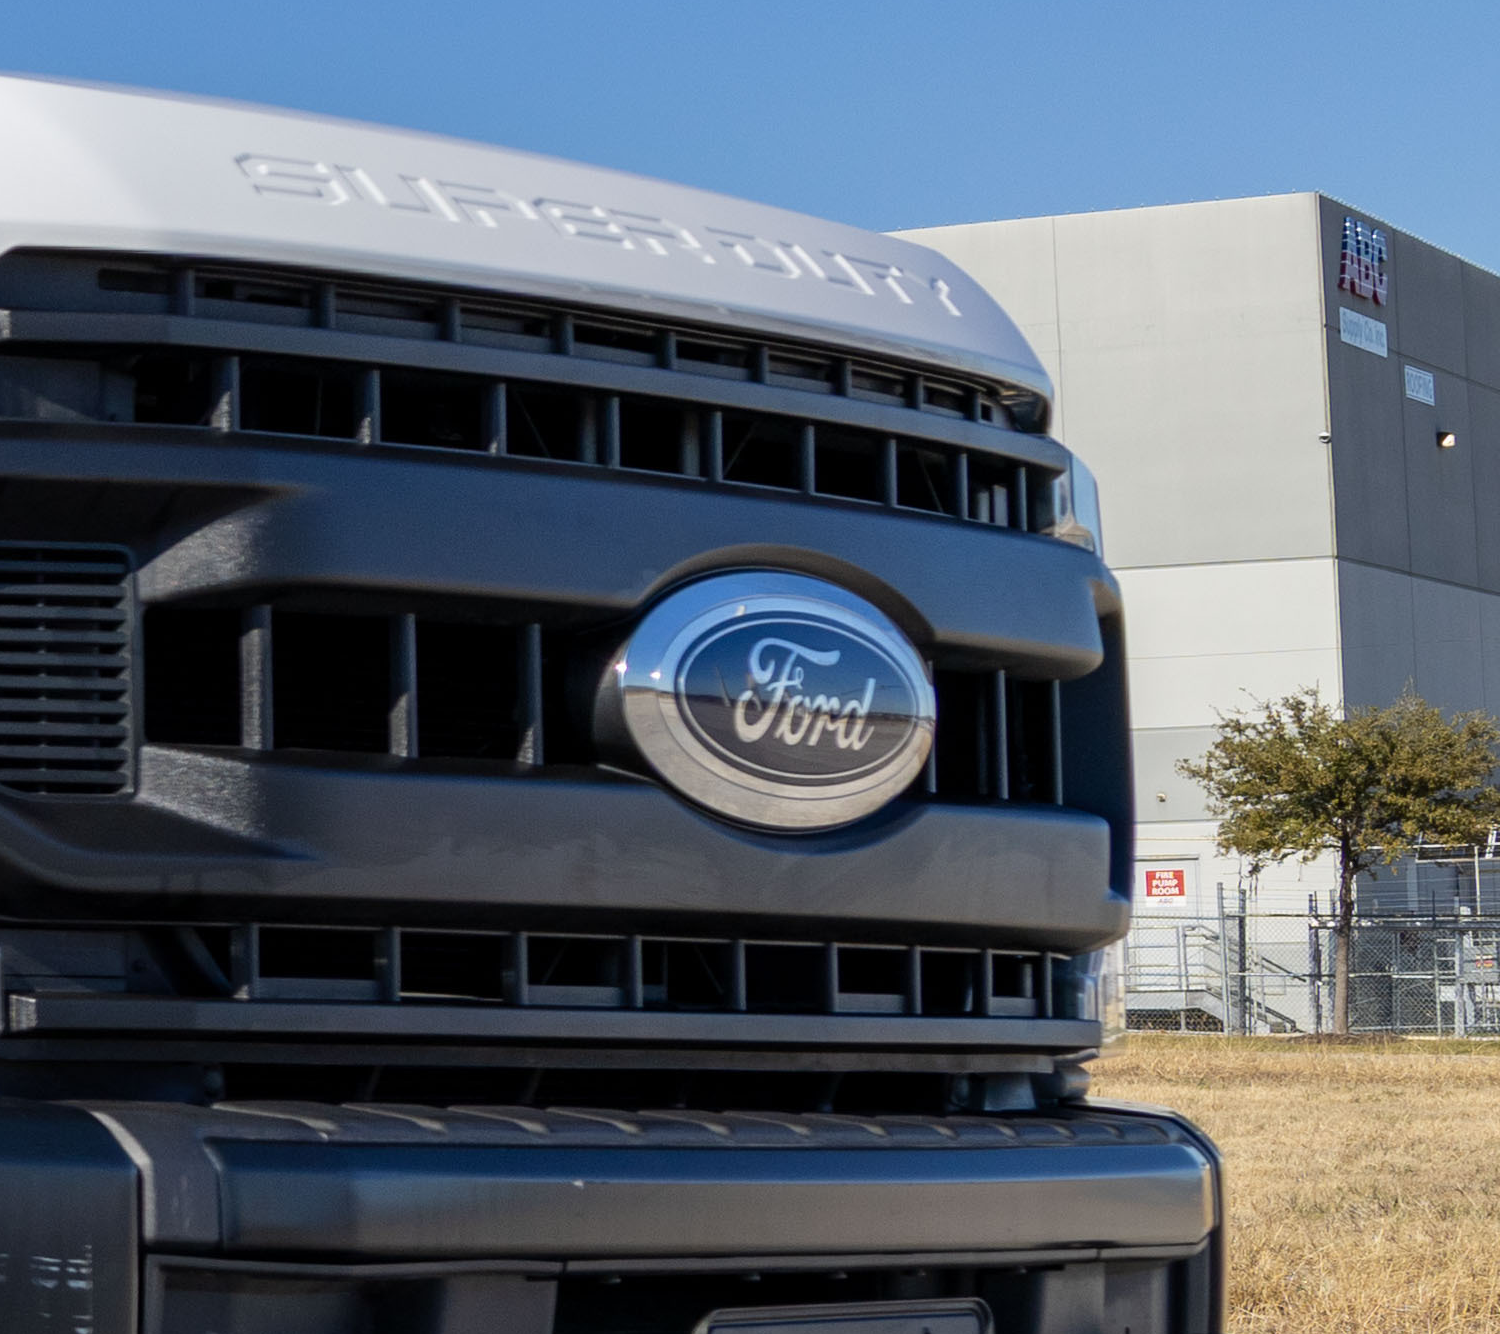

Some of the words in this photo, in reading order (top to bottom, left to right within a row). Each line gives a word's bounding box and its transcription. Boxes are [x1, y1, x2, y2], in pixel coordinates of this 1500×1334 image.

[234, 152, 717, 264] SUPER
[704, 225, 962, 317] DUTY
[1337, 216, 1388, 306] ABC
[734, 637, 876, 750] Ford
[1152, 879, 1178, 887] PUMP
[1152, 887, 1180, 895] ROOM
